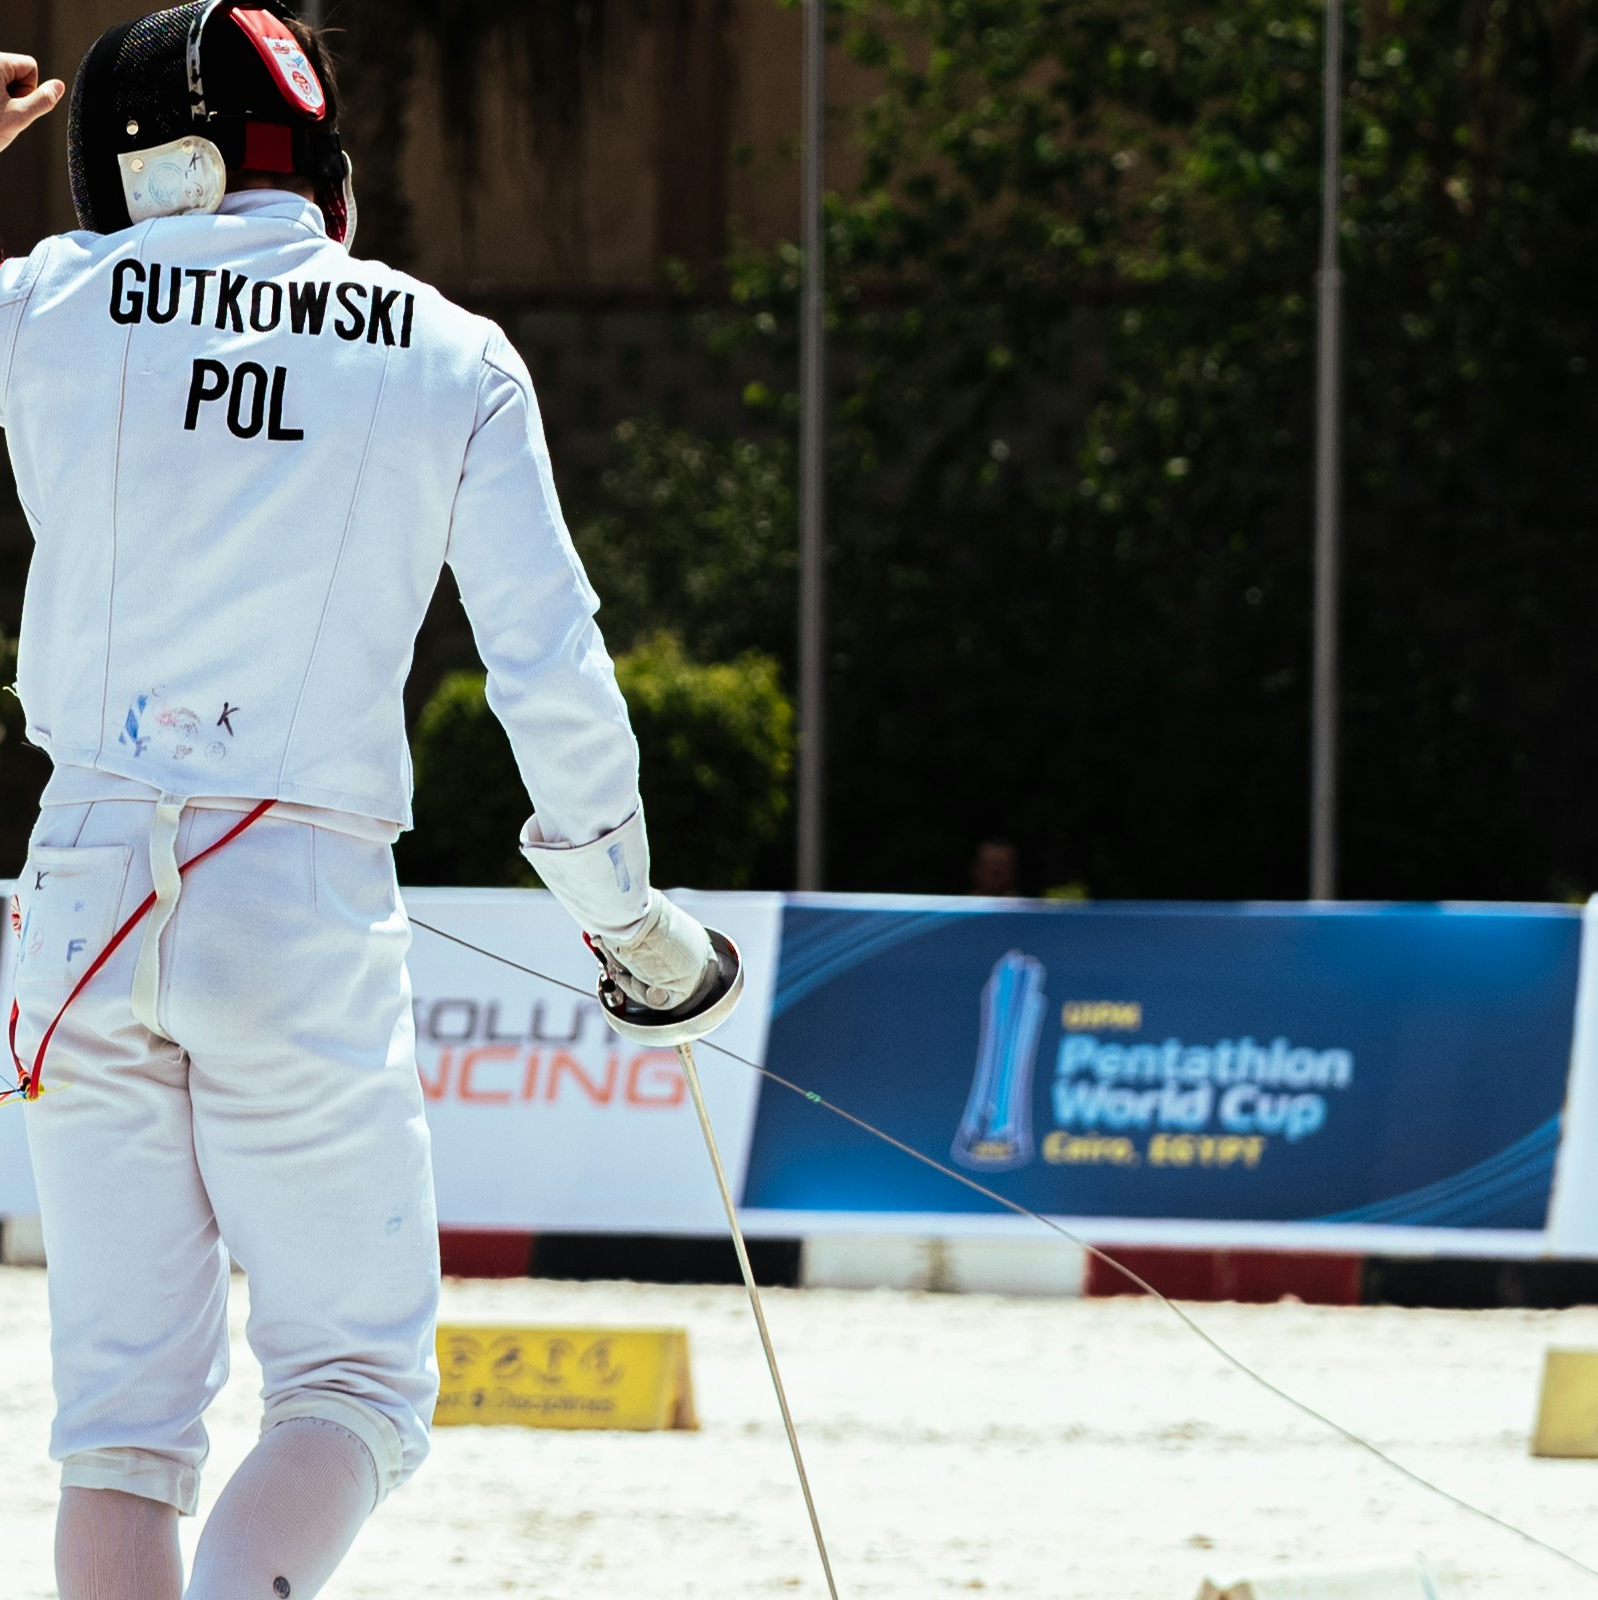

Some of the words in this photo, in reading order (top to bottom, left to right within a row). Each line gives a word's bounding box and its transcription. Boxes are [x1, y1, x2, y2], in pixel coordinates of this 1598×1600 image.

[109, 258, 415, 348] GUTKOWSKI
[184, 359, 304, 440] POL
[216, 701, 241, 738] K
[66, 938, 88, 962] F
[412, 996, 623, 1045] OLU
[1056, 1033, 1356, 1088] Pentathlon
[1052, 1079, 1217, 1129] World
[1219, 1083, 1328, 1142] Cup
